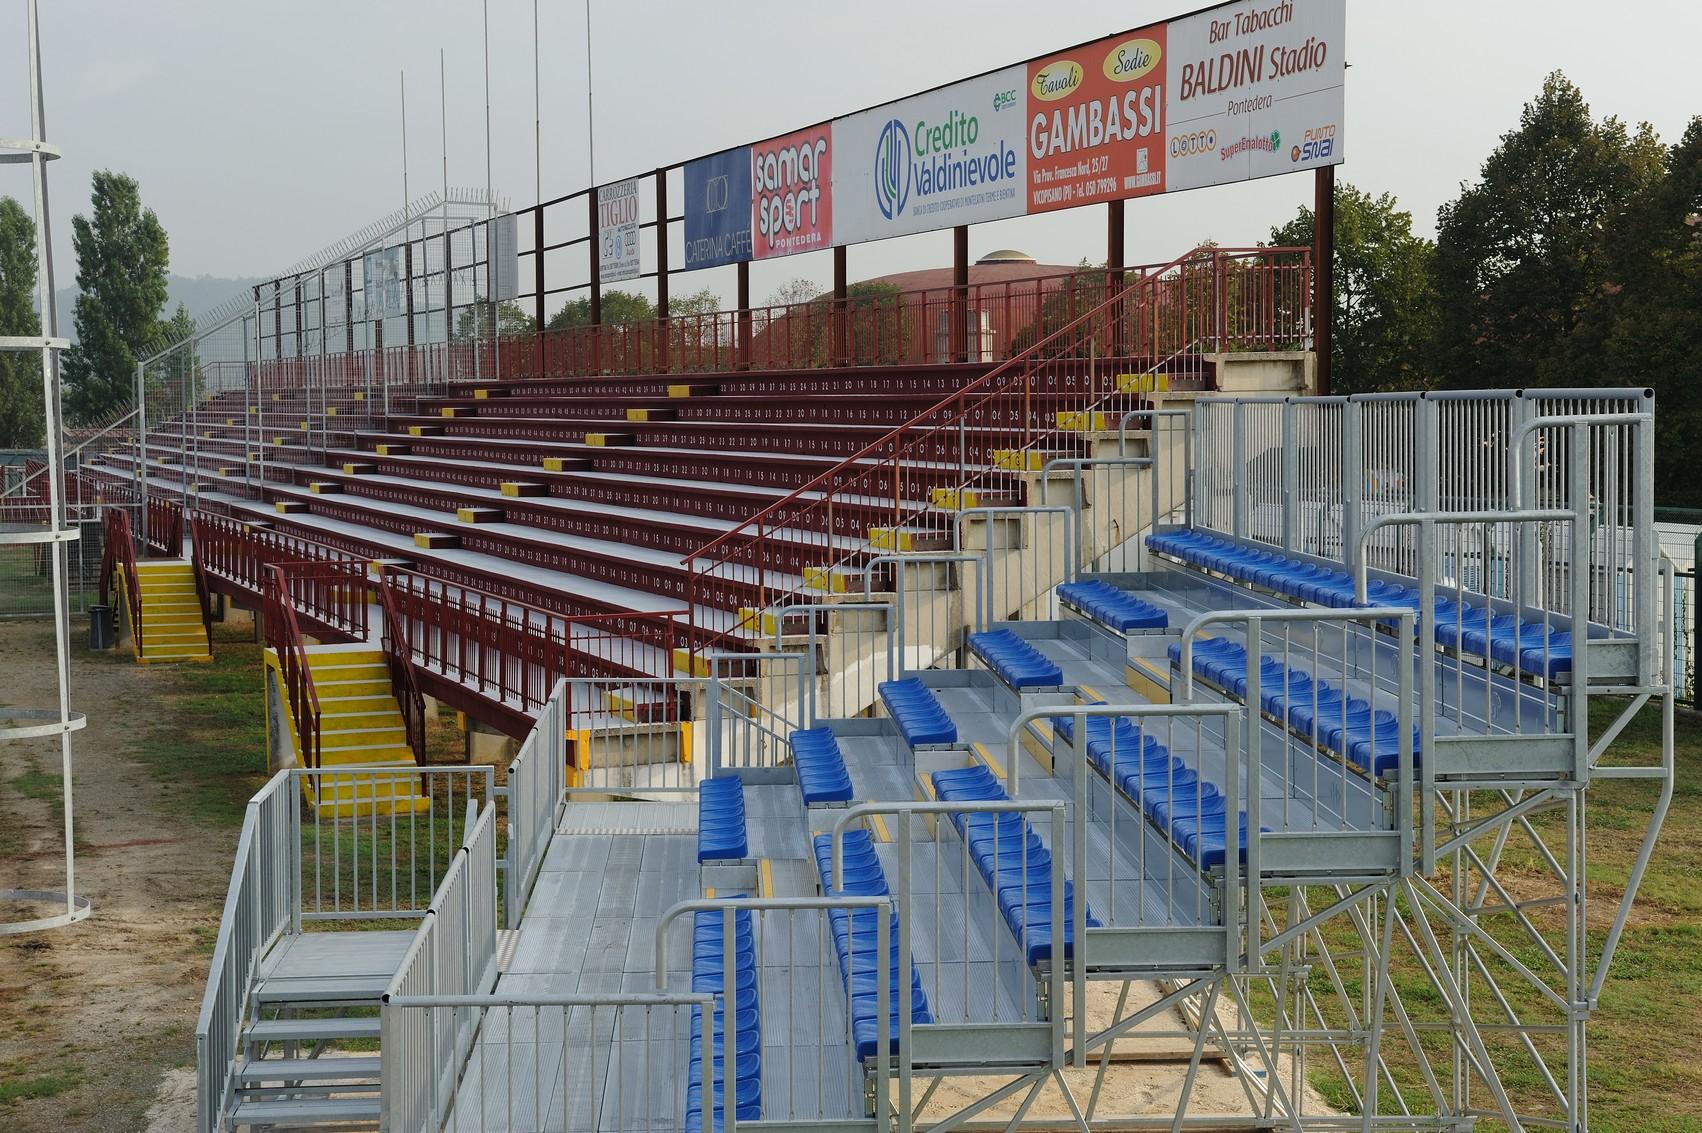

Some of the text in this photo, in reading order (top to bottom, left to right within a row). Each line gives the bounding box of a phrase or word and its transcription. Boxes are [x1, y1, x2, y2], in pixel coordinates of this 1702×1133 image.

[1209, 0, 1293, 44] Bar Tabacchi
[1113, 46, 1152, 74] Sedie
[1180, 36, 1327, 101] BALDINI Stadio
[1037, 66, 1080, 95] Tavoli
[1227, 94, 1273, 116] Pontedera
[914, 110, 979, 157] Credito
[1030, 84, 1161, 160] GAMBASSI
[1304, 124, 1336, 141] PUNTO
[1220, 136, 1273, 161] SuperEnalotto
[755, 136, 827, 194] samar
[913, 139, 1016, 197] Valdinievole
[599, 181, 637, 203] CARROZZERIA
[600, 195, 637, 227] TIGLIO
[758, 178, 821, 249] sport
[685, 234, 723, 264] CATERINA
[775, 231, 822, 249] PONTEDERA
